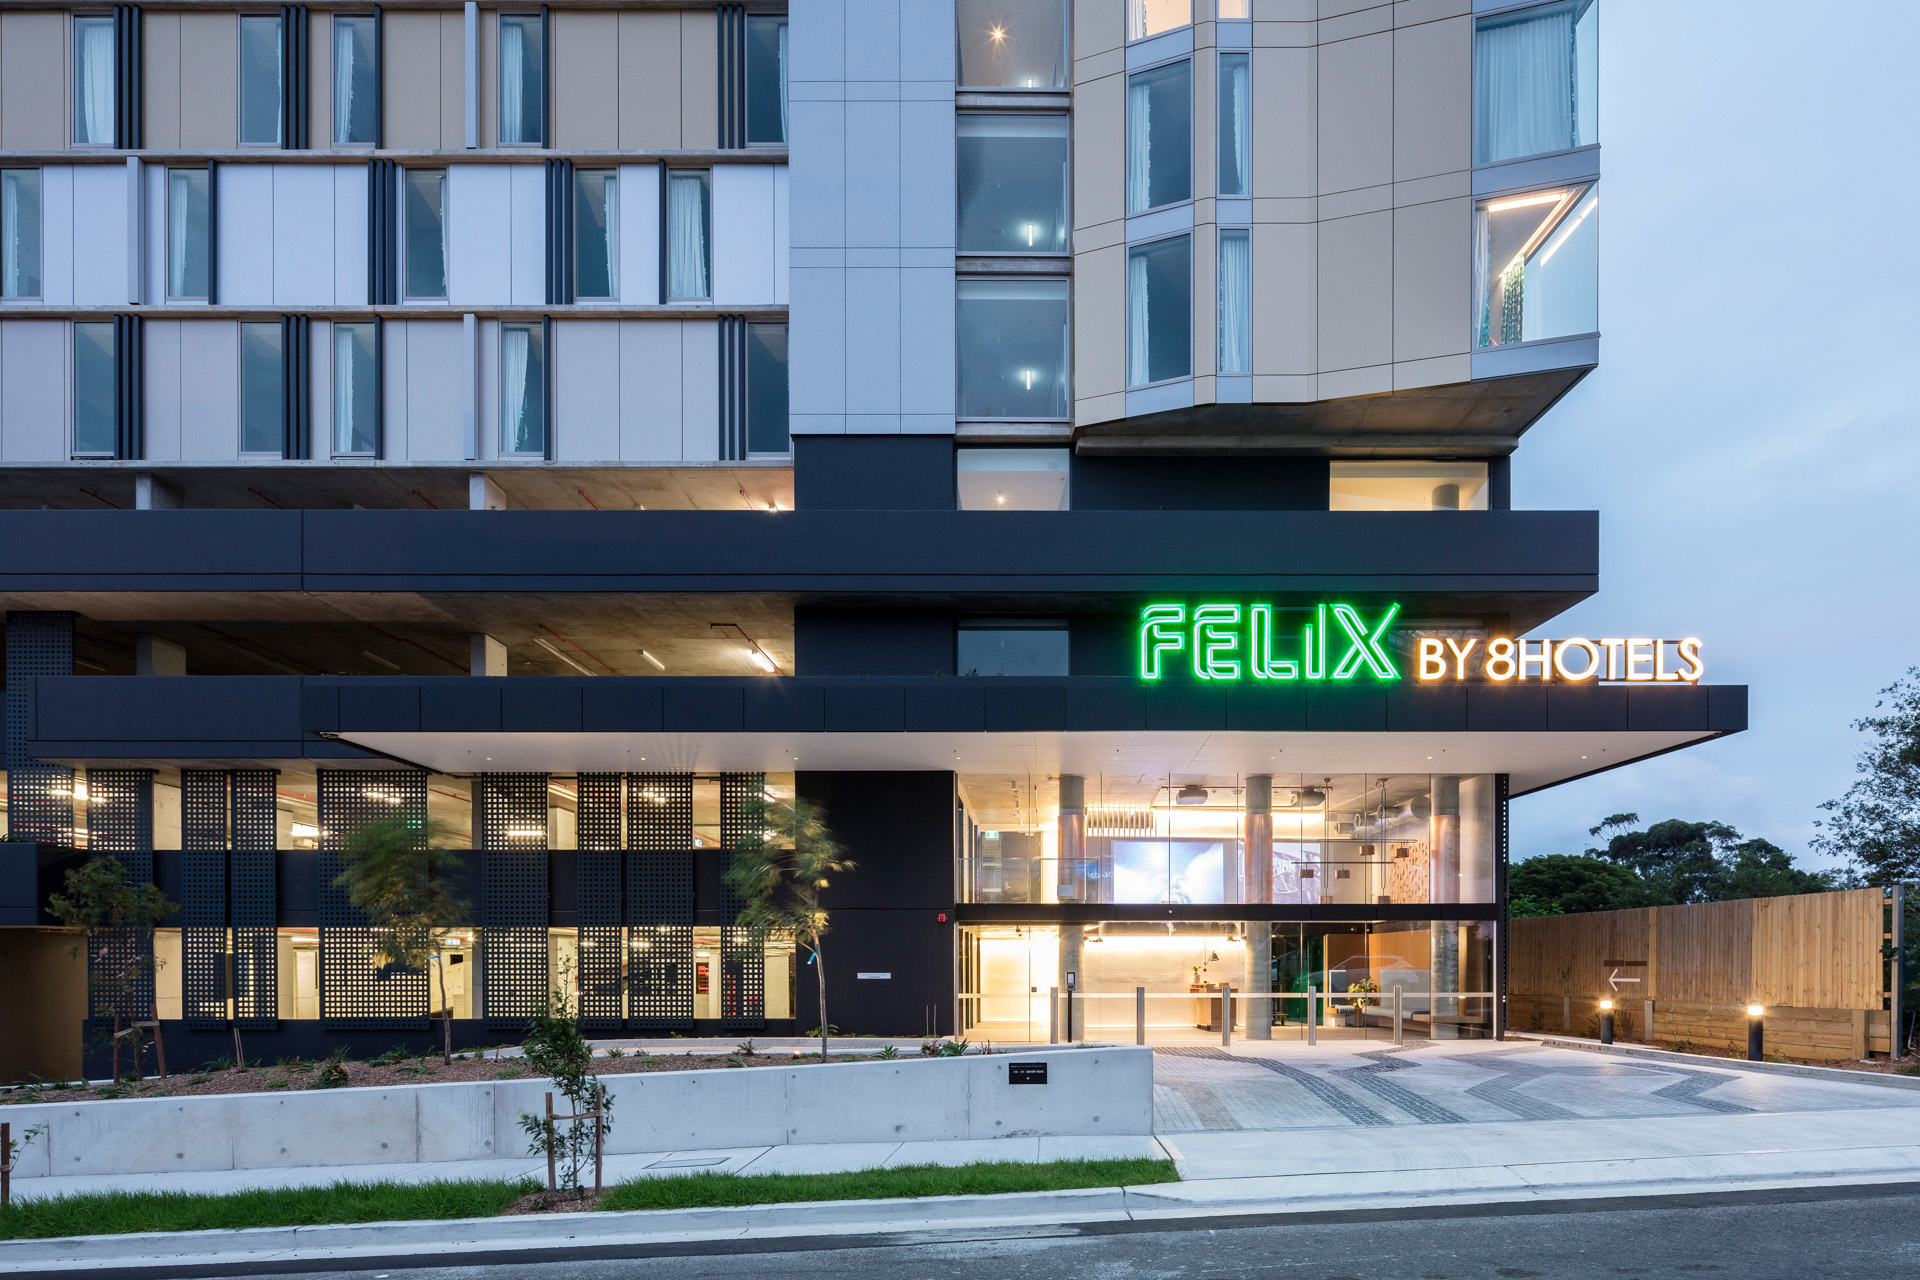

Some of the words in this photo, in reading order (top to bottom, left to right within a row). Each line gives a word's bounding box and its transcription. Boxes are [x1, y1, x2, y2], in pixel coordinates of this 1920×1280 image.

[1141, 602, 1401, 679] FELIX
[1419, 638, 1477, 680] BY
[1486, 637, 1704, 680] 8HOTELS
